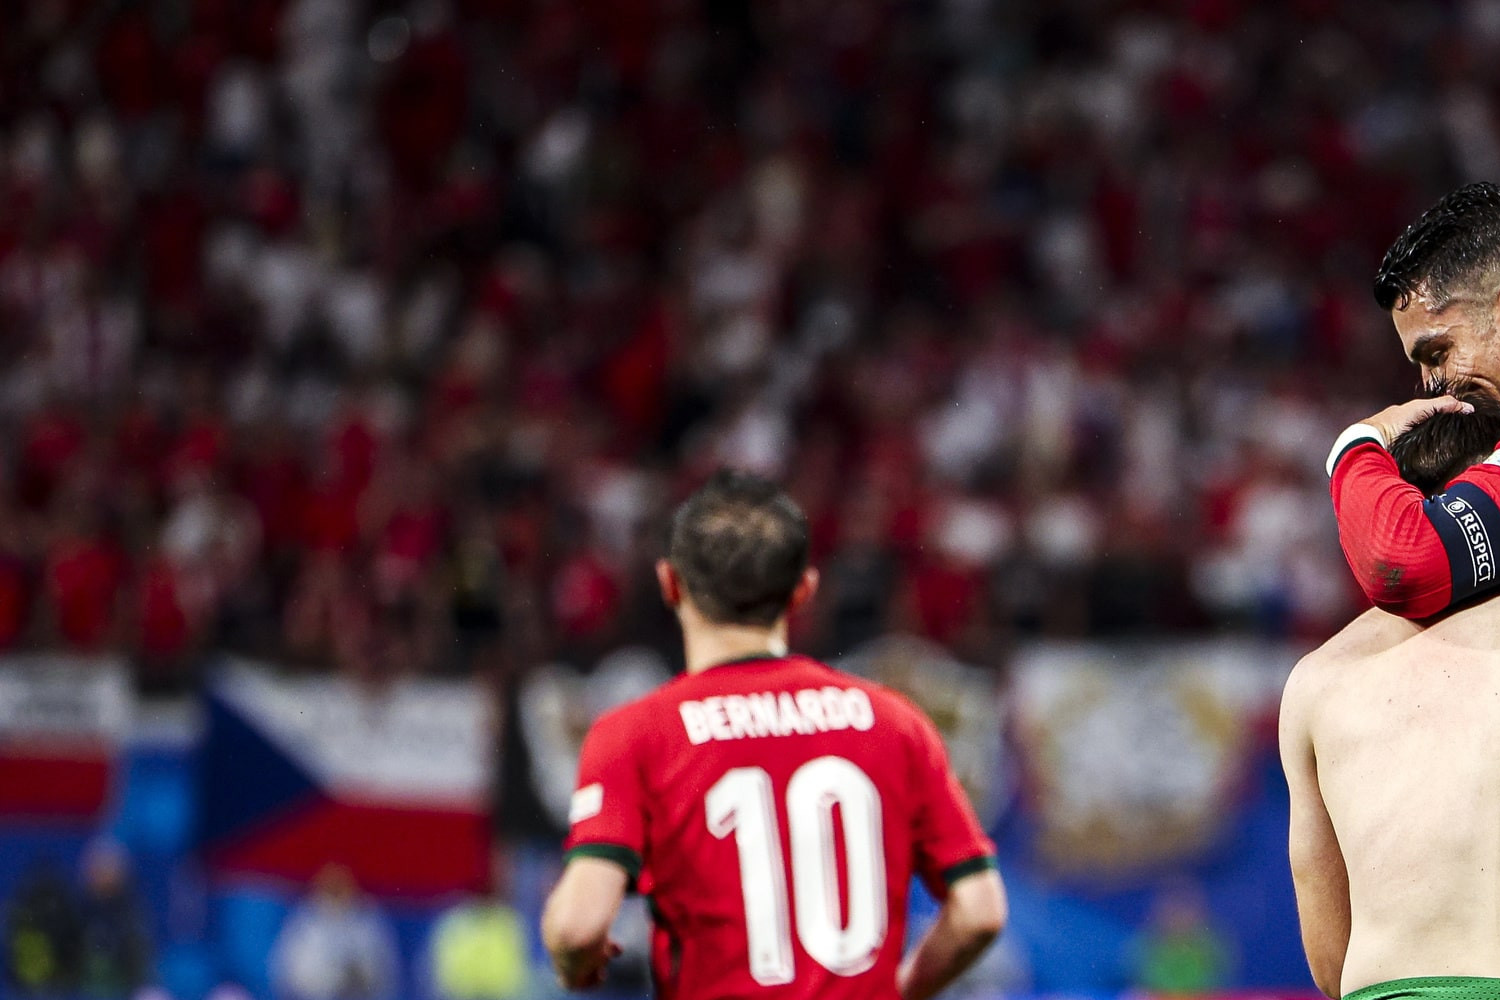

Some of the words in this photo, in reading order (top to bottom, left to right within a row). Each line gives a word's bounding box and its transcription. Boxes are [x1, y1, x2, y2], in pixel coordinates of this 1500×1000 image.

[1460, 512, 1491, 582] RESPECT
[679, 686, 875, 746] BERNARDO
[705, 755, 889, 988] 10
